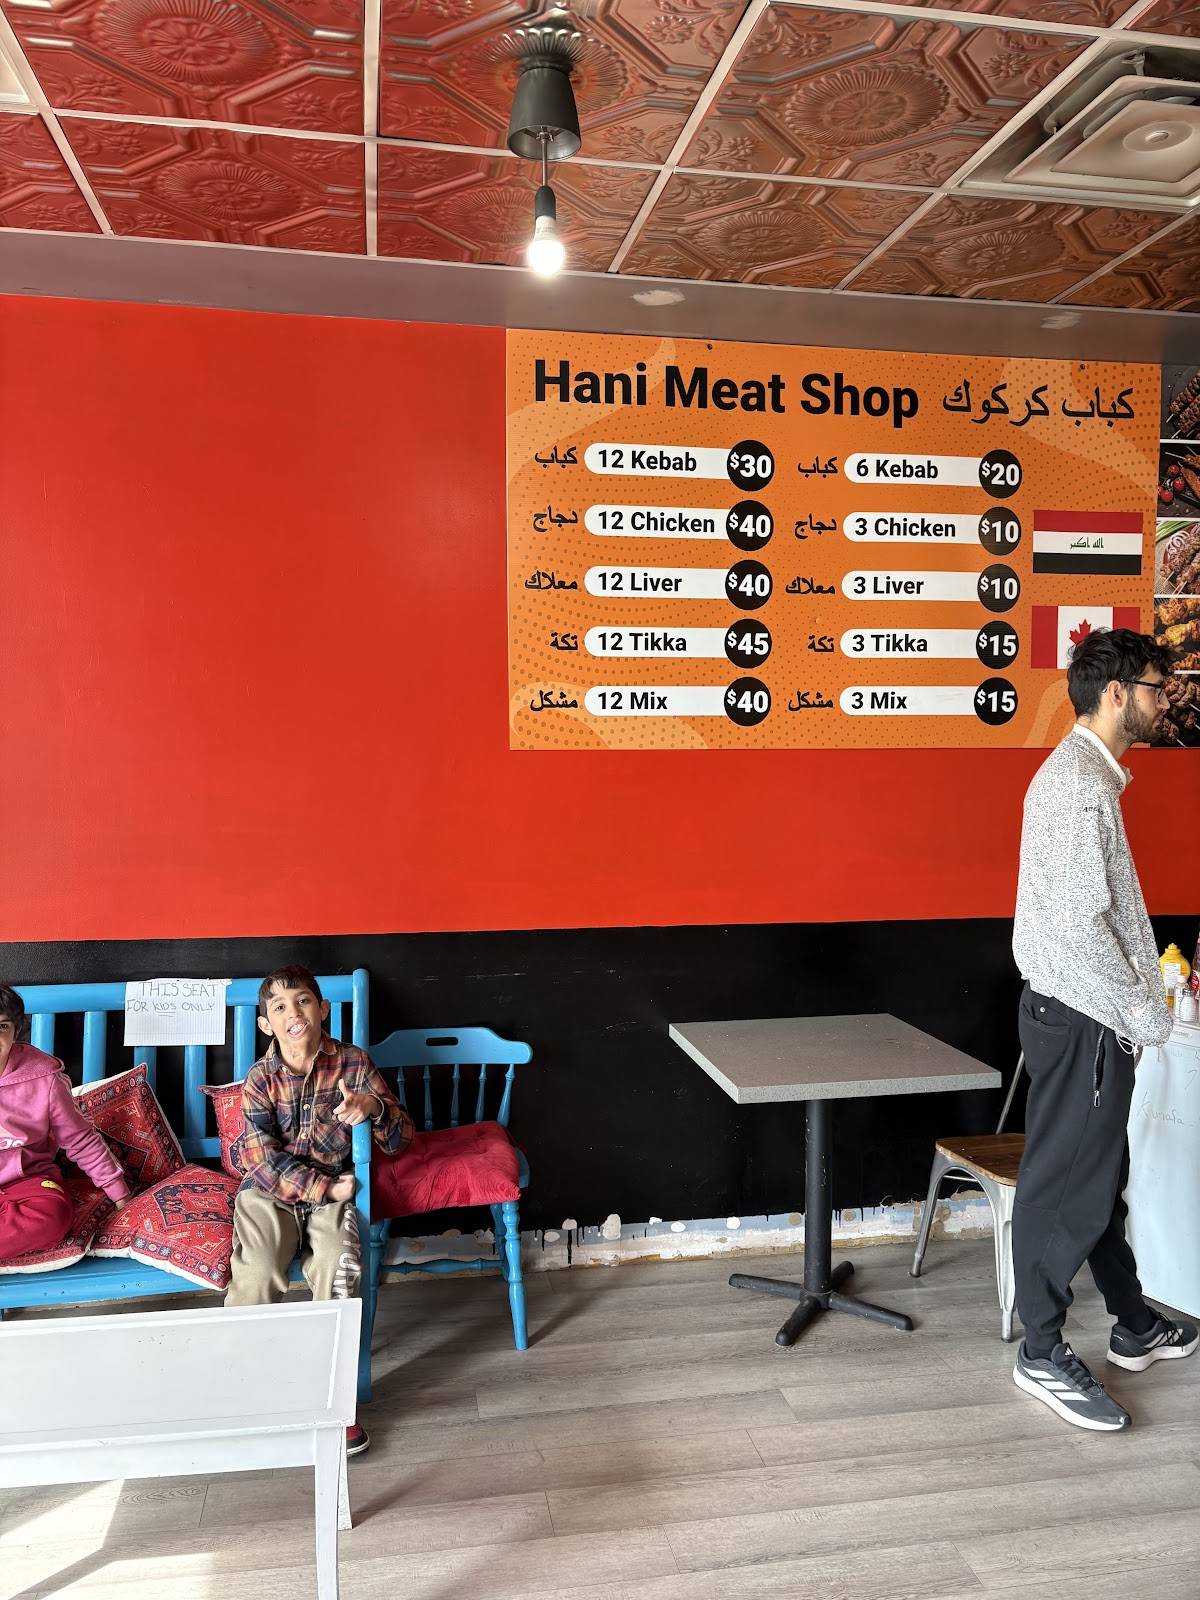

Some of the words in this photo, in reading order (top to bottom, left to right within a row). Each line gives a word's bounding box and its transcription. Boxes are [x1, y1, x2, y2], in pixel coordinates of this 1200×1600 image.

[535, 359, 647, 406] Hani
[665, 365, 786, 414] Meat
[800, 372, 919, 429] Shop
[942, 378, 1050, 427] كركوك
[1061, 386, 1135, 428] كباب
[534, 445, 578, 469] كباب
[598, 449, 624, 469] 12
[631, 450, 697, 472] Kebab
[729, 451, 773, 478] $30
[797, 456, 838, 479] كباب
[856, 458, 869, 477] 6
[875, 459, 939, 479] Kebab
[981, 461, 1020, 486] $20
[533, 505, 578, 533] دجاج
[598, 511, 624, 530] 12
[630, 511, 715, 533] Chicken
[728, 513, 772, 538] $40
[794, 513, 837, 540] دجاج
[855, 517, 868, 536] 3
[874, 517, 956, 537] Chicken
[980, 518, 1019, 544] $10
[524, 570, 578, 590] معلاك
[598, 572, 624, 591] 12
[630, 572, 683, 592] Liver
[727, 572, 771, 597] $40
[785, 576, 836, 595] معلاك
[853, 576, 866, 595] 3
[873, 575, 925, 595] Liver
[979, 575, 1018, 600] $10
[549, 631, 579, 651] تكة
[598, 632, 623, 651] 12
[628, 632, 687, 652] Tikka
[726, 631, 770, 656] $45
[807, 634, 835, 653] تكة
[852, 634, 865, 652] 3
[870, 633, 928, 652] Tikka
[978, 632, 1017, 657] $15
[530, 689, 578, 712] مشكل
[598, 691, 623, 710] 12
[630, 691, 668, 710] Mix
[726, 689, 769, 714] $40
[788, 690, 834, 712] مشكل
[851, 691, 864, 710] 3
[870, 691, 907, 710] Mix
[976, 689, 1016, 714] $15
[140, 981, 180, 997] THIS
[181, 982, 218, 998] SEAT
[126, 998, 149, 1012] FOR
[152, 1001, 177, 1011] KIDS
[181, 1001, 215, 1012] ONLY
